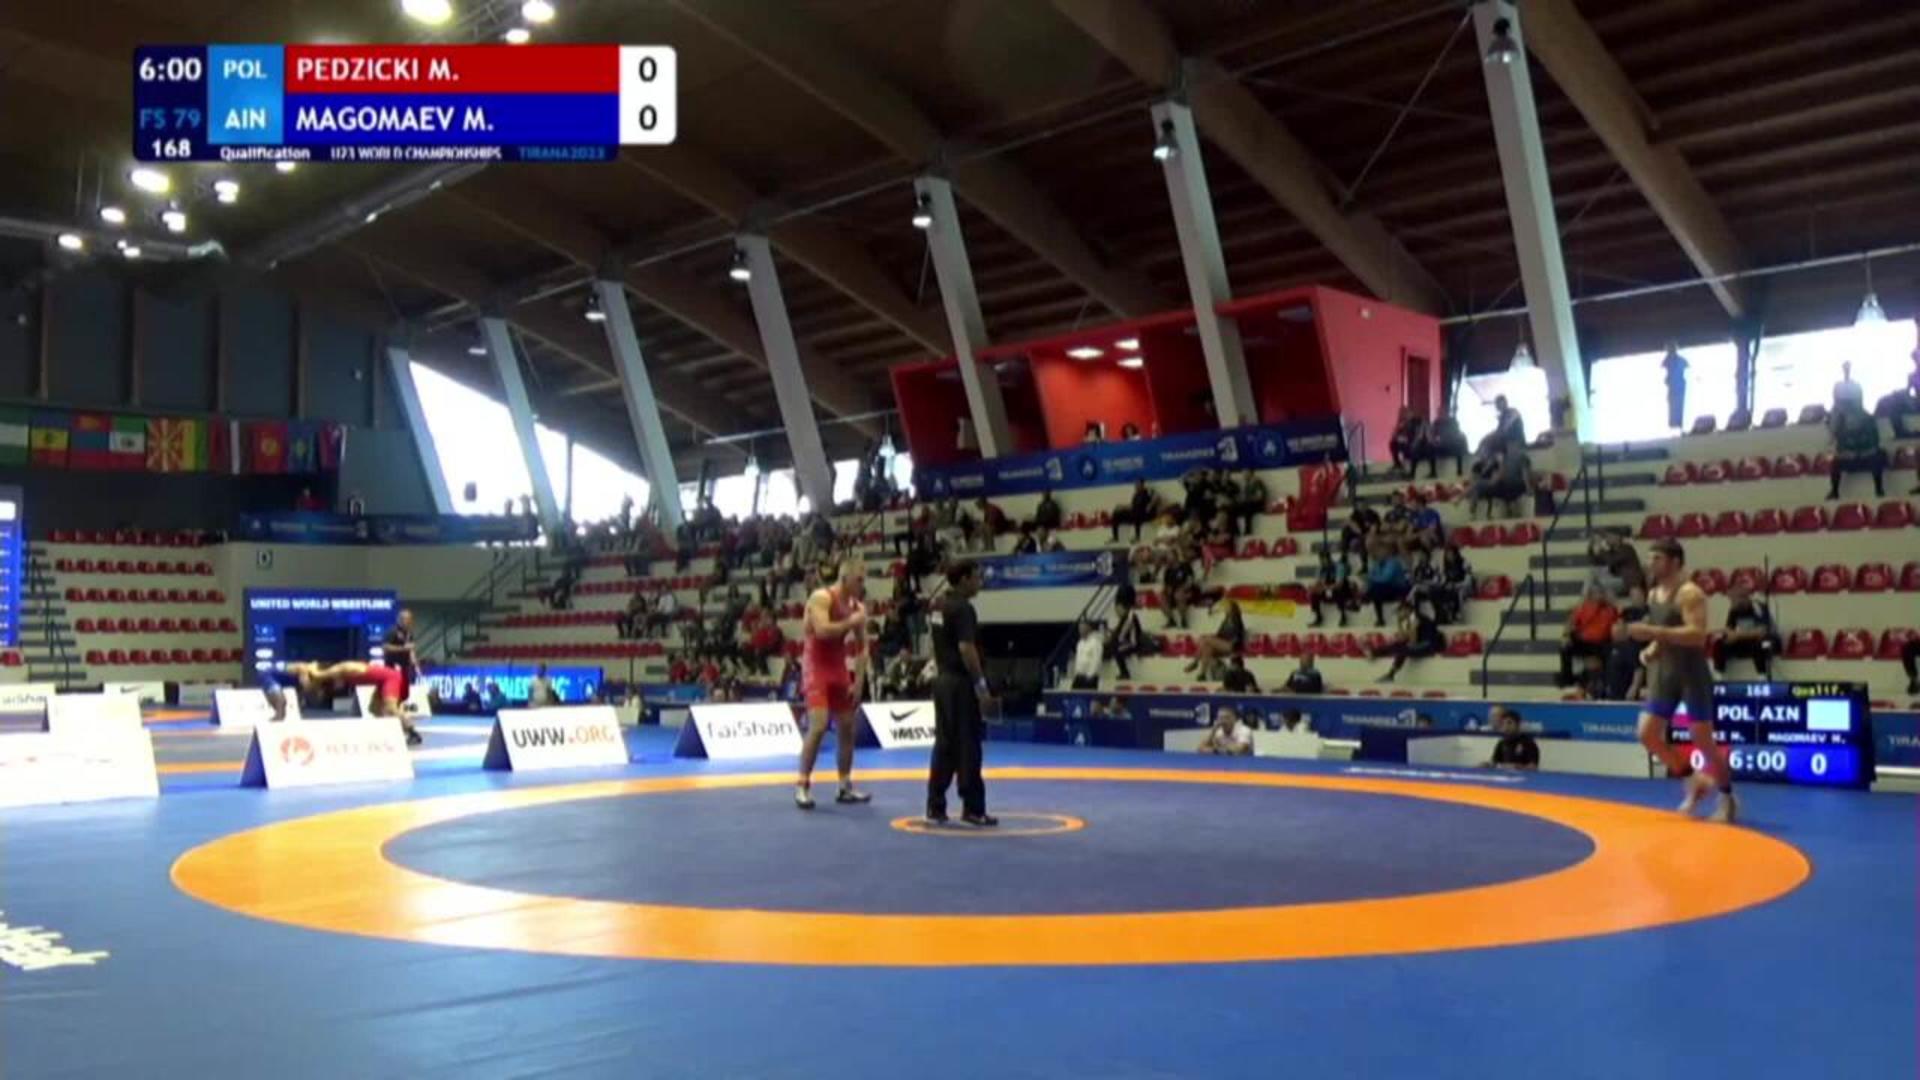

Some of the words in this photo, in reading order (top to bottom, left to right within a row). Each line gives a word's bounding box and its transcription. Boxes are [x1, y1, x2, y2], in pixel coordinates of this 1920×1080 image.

[250, 598, 290, 609] UNITED
[292, 598, 330, 609] WORLD
[1746, 685, 1771, 697] 168
[1717, 705, 1755, 721] POL
[1760, 706, 1800, 722] AIN
[511, 725, 616, 749] UWW.ORG
[1728, 750, 1787, 771] 6:00
[1810, 752, 1828, 775] 0
